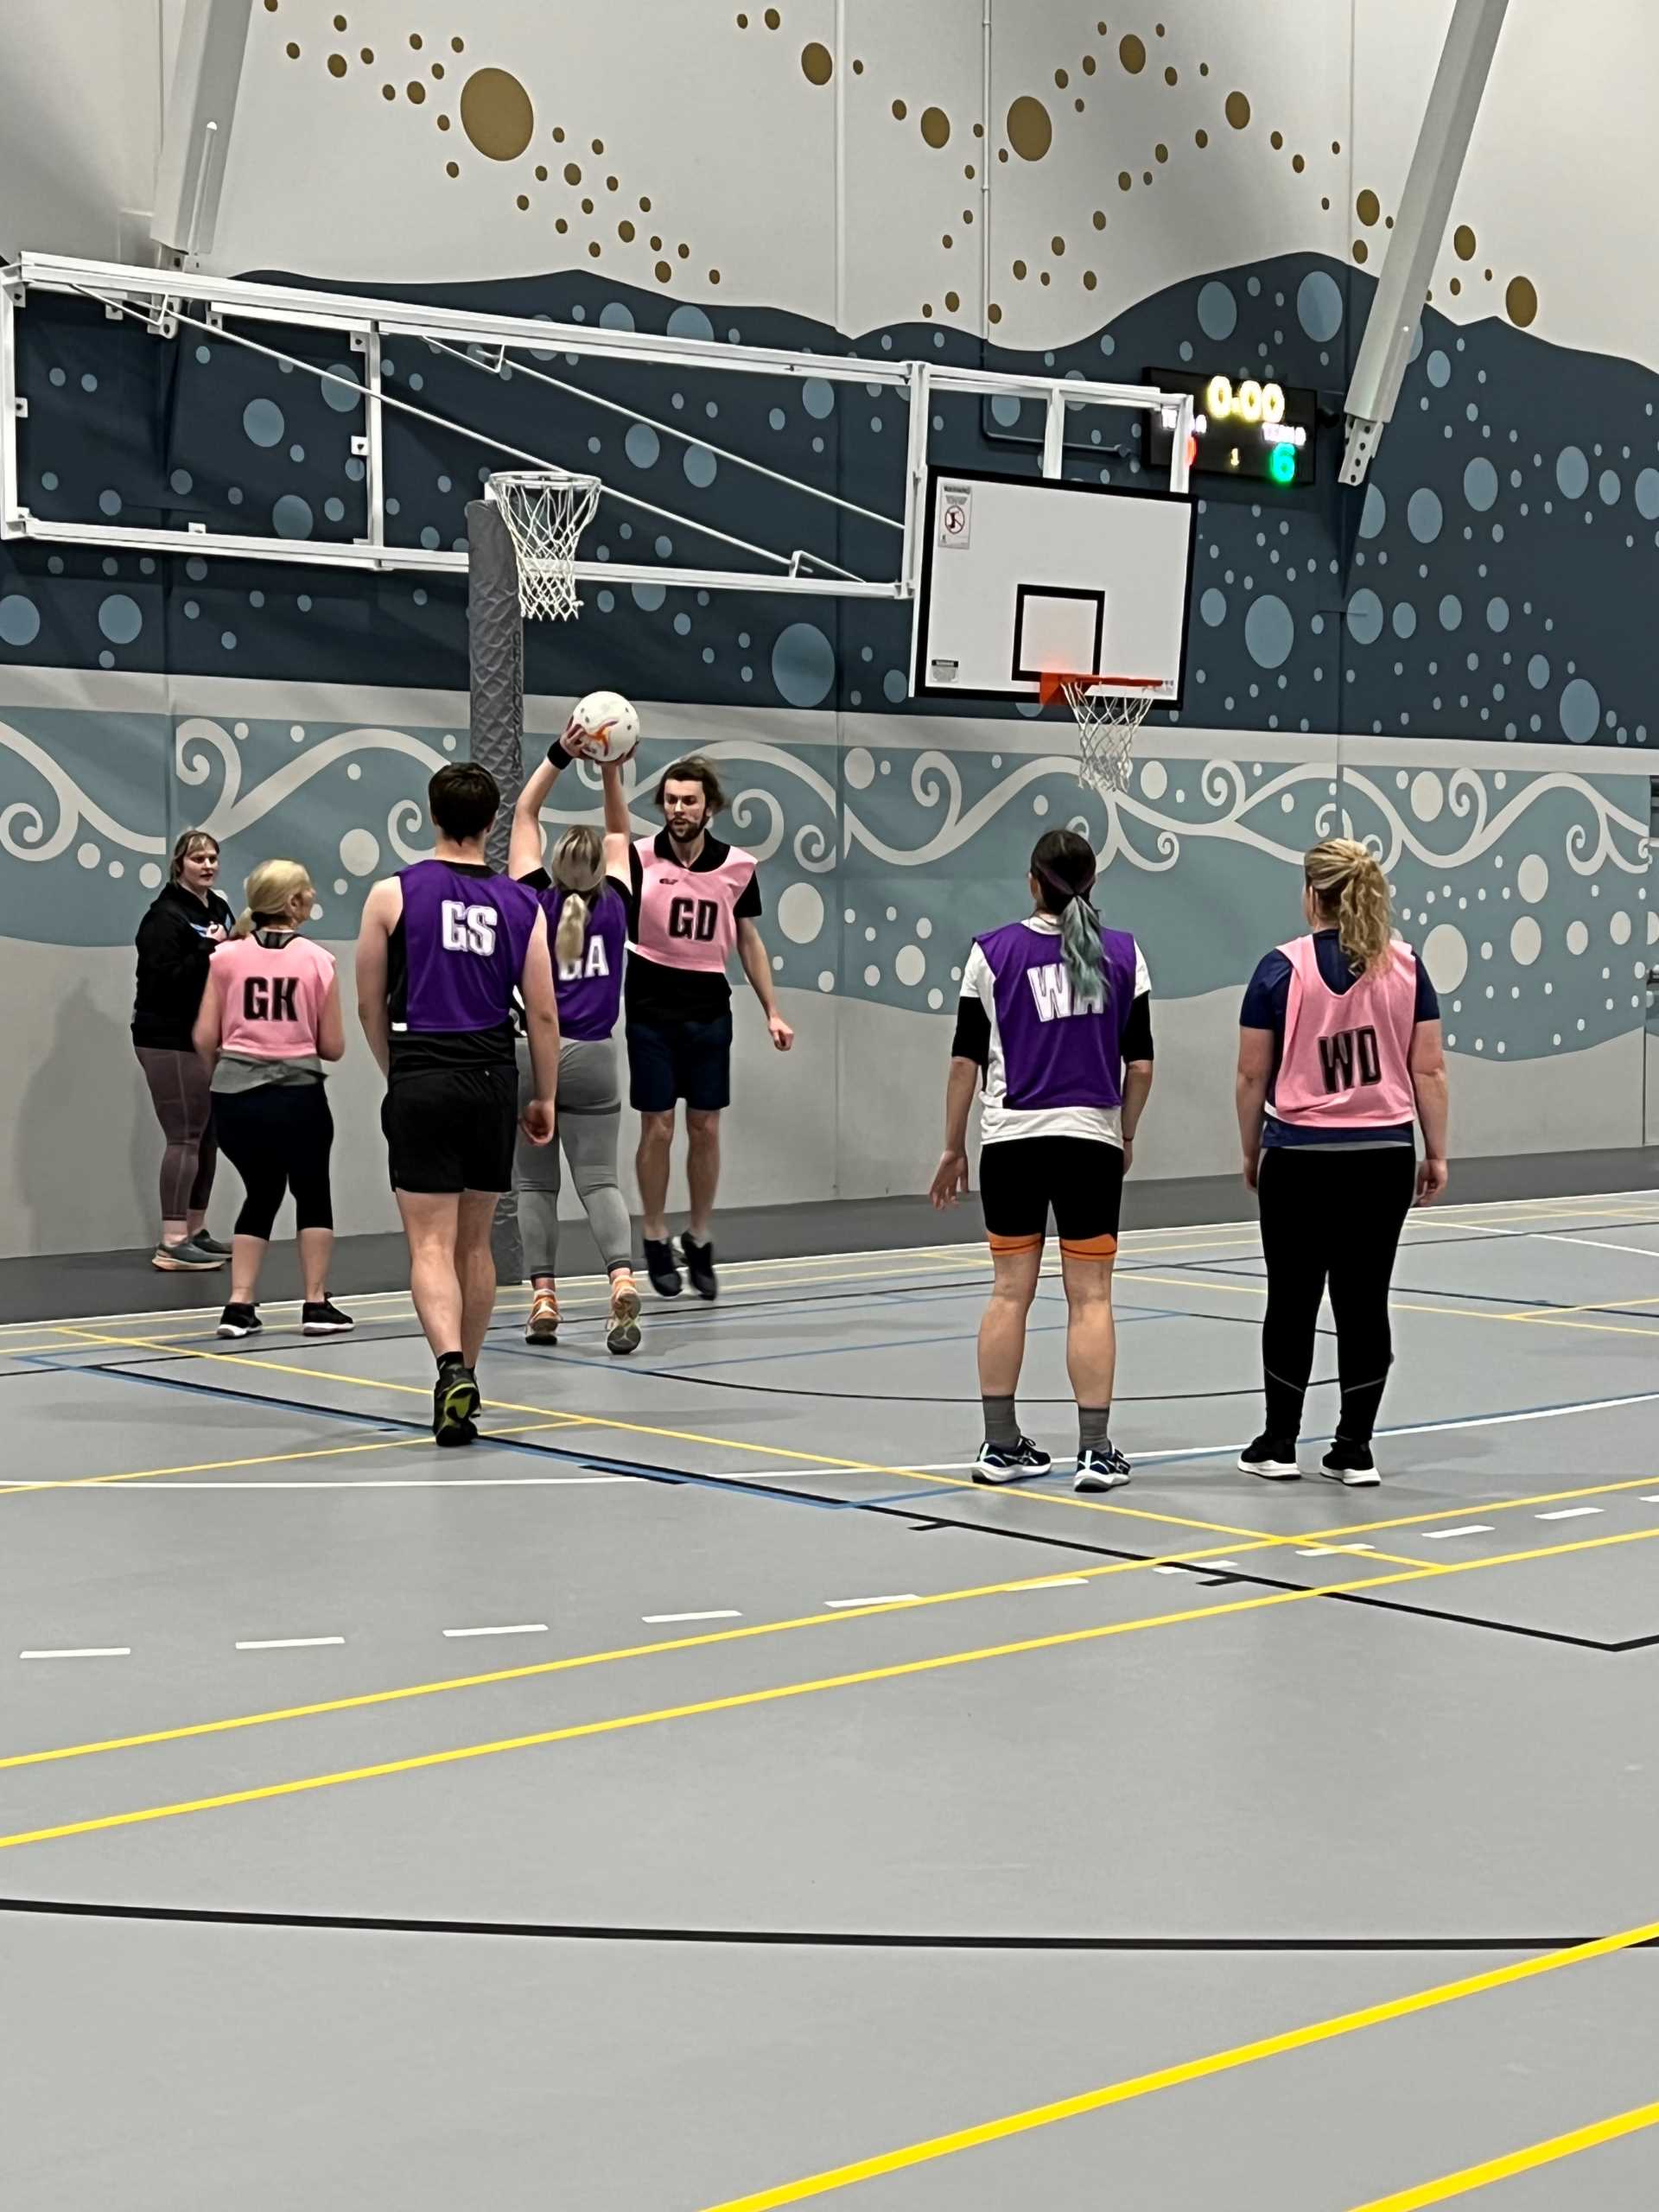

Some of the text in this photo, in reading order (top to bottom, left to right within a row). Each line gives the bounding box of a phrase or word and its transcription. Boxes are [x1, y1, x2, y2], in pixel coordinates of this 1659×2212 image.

[1271, 442, 1296, 482] 6
[442, 899, 498, 957] GS
[668, 896, 719, 942] GD
[244, 976, 299, 1021] GK
[1318, 1025, 1382, 1095] WD
